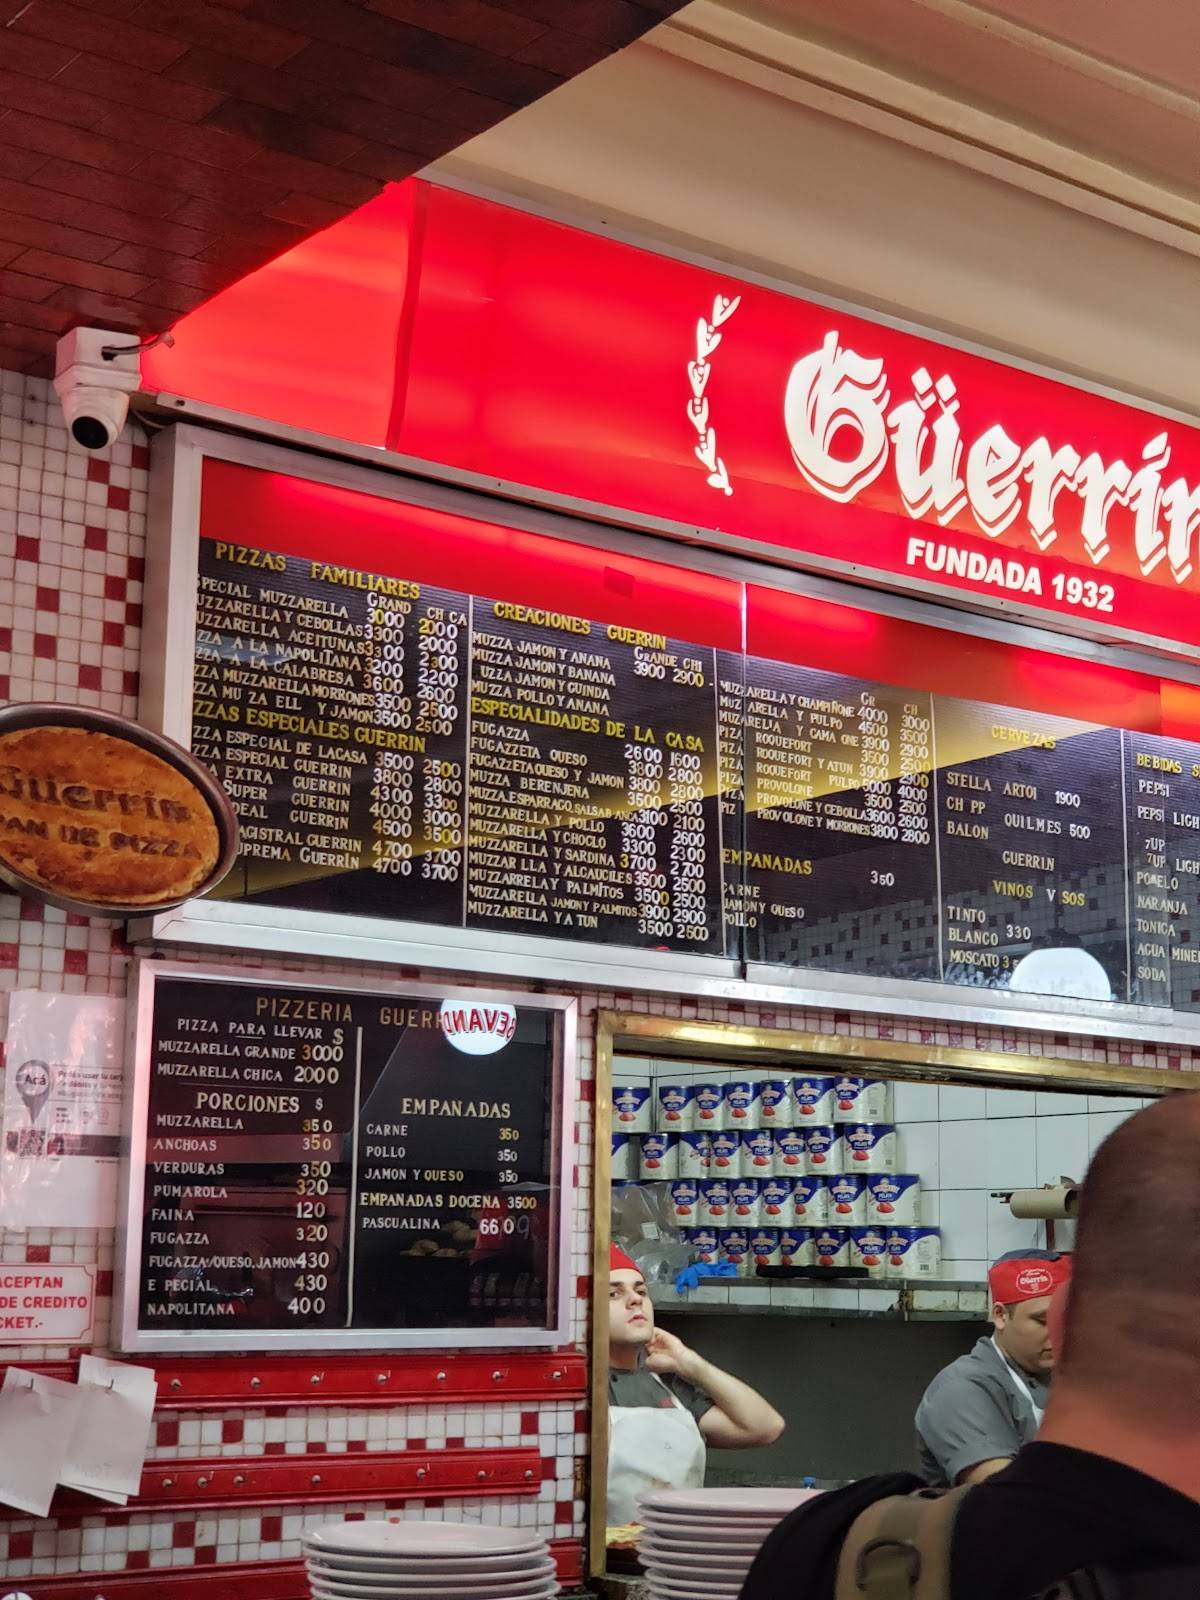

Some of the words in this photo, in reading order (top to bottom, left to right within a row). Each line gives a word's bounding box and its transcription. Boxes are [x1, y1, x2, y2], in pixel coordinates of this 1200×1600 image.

[215, 542, 287, 571] PIZZAS
[311, 562, 421, 599] FAMILIARES
[906, 538, 1043, 596] FUNDADA
[1051, 574, 1116, 613] 1932
[260, 588, 348, 619] MUZZARELLA
[367, 608, 405, 628] 3000
[493, 601, 591, 635] CREACIONES
[606, 624, 667, 650] GUERRIN
[419, 635, 457, 655] 2000
[472, 631, 513, 650] MUZZA
[516, 640, 556, 659] JAMON
[570, 652, 611, 670] ANANA
[419, 668, 458, 688] 2200
[472, 647, 513, 667] MUZZA
[515, 656, 555, 674] JAMON
[568, 666, 616, 686] BANANA
[633, 661, 666, 680] 3900
[673, 668, 704, 687] 2900
[273, 661, 354, 687] CALABRESA
[363, 674, 404, 694] 3600
[417, 684, 455, 704] 2600
[515, 672, 555, 690] JAMON
[471, 680, 512, 698] MUZZA
[517, 688, 555, 705] POLLO
[566, 698, 610, 717] ANANA
[471, 697, 600, 733] ESPECIALIDADES
[665, 732, 704, 753] CASA
[810, 713, 842, 730] PULPO
[858, 721, 888, 737] 4500
[900, 729, 927, 745] 3500
[857, 707, 888, 724] 4000
[902, 715, 930, 731] 3000
[246, 708, 350, 740] ESPECIALES
[354, 726, 426, 753] GUERRIN
[226, 730, 292, 752] ESPECIAL
[375, 751, 414, 771] 3500
[423, 759, 461, 779] 2500
[471, 720, 530, 742] FUGAZZA
[624, 744, 662, 763] 2600
[670, 752, 700, 770] 1600
[861, 735, 890, 752] 3900
[900, 743, 928, 759] 2900
[471, 737, 541, 759] FUGAZZETA
[628, 760, 663, 779] 3800
[668, 767, 702, 785] 2800
[861, 750, 889, 766] 3500
[1136, 753, 1182, 774] BEBIDAS
[226, 748, 289, 769] ESPECIAL
[293, 759, 352, 779] GUERRIN
[373, 768, 413, 788] 3800
[424, 776, 462, 796] 2800
[827, 761, 853, 775] ATUN
[859, 764, 888, 779] 3900
[225, 765, 273, 785] EXTRA
[293, 776, 351, 796] GUERRIN
[370, 785, 413, 805] 4300
[469, 769, 510, 787] MUZZA
[520, 777, 590, 799] BERENJENA
[587, 772, 624, 789] JAMON
[628, 776, 661, 794] 3800
[670, 783, 704, 801] 2800
[897, 786, 927, 801] 4000
[946, 771, 991, 792] STELLA
[1003, 782, 1037, 800] ARTOI
[1055, 790, 1080, 808] 1900
[1139, 779, 1170, 798] PEPSI
[223, 779, 268, 800] SUPER
[291, 793, 350, 813] GUERRIN
[369, 802, 412, 821] 4000
[423, 809, 461, 828] 3000
[757, 778, 814, 797] PROVOLONE
[864, 794, 892, 810] 3500
[899, 800, 926, 815] 2500
[290, 810, 349, 830] GUERRIN
[372, 819, 412, 838] 4500
[469, 802, 550, 824] MUZZARELLA
[568, 817, 605, 833] POLLO
[621, 822, 655, 840] 3600
[673, 830, 705, 847] 2600
[824, 803, 867, 821] CEBOLLA
[866, 808, 895, 825] 3600
[898, 813, 928, 830] 2600
[1137, 805, 1164, 822] PEPSI
[469, 818, 548, 842] MUZZARELLA
[622, 838, 656, 856] 3300
[870, 825, 898, 841] 3800
[901, 828, 930, 844] 2800
[946, 820, 989, 840] BALON
[1069, 823, 1091, 839] 500
[306, 833, 363, 853] GUERRIN
[372, 840, 412, 859] 4700
[424, 848, 461, 866] 3700
[469, 835, 548, 857] MUZZARELLA
[565, 849, 616, 868] SARDINA
[620, 853, 656, 871] 3700
[1145, 838, 1165, 852] 7UP
[300, 847, 360, 869] GUERRIN
[372, 858, 412, 876] 4700
[421, 863, 458, 882] 3700
[722, 849, 813, 875] EMPANADAS
[1002, 850, 1055, 872] GUERRIN
[1146, 853, 1166, 868] 7UP
[870, 870, 895, 887] 350
[1136, 871, 1178, 890] POMELO
[992, 880, 1034, 899] VINOS
[1062, 891, 1085, 907] SOS
[467, 901, 548, 923] MUZZARELLA
[947, 905, 986, 923] TINTO
[1136, 895, 1188, 915] NARANJA
[673, 908, 706, 925] 2900
[948, 927, 999, 946] BLANCO
[1006, 924, 1032, 940] 330
[1136, 919, 1176, 937] TONICA
[950, 949, 999, 967] MOSCATO
[1136, 943, 1166, 958] AGUA
[1137, 966, 1166, 982] SODA
[256, 997, 353, 1022] PIZZERIA
[177, 1018, 218, 1033] PIZZA
[228, 1022, 266, 1036] PARA
[274, 1026, 323, 1040] LLEVAR
[158, 1040, 240, 1057] MUZZARELLA
[302, 1044, 344, 1062] 3000
[24, 1074, 46, 1086] Acá
[157, 1063, 240, 1080] MUZZARELLA
[243, 1068, 283, 1082] CHICA
[293, 1066, 339, 1084] 2000
[196, 1092, 300, 1114] PORCIONES
[401, 1098, 511, 1120] EMPANADAS
[156, 1114, 244, 1130] MUZZARELLA
[366, 1123, 409, 1137] CARNE
[153, 1138, 217, 1151] ANCHOAS
[365, 1146, 405, 1158] POLLO
[153, 1161, 225, 1175] VERDURAS
[364, 1168, 407, 1181] JAMON
[153, 1185, 228, 1198] PUMAROLA
[359, 1192, 443, 1208] EMPANADAS
[449, 1195, 500, 1209] DOCENA
[151, 1209, 195, 1221] FAINA
[296, 1202, 326, 1219] 120
[362, 1218, 440, 1230] PASCUALINA
[150, 1232, 209, 1245] FUGAZZA
[23, 1296, 88, 1308] CREDITO
[147, 1303, 235, 1316] NAPOLITANA
